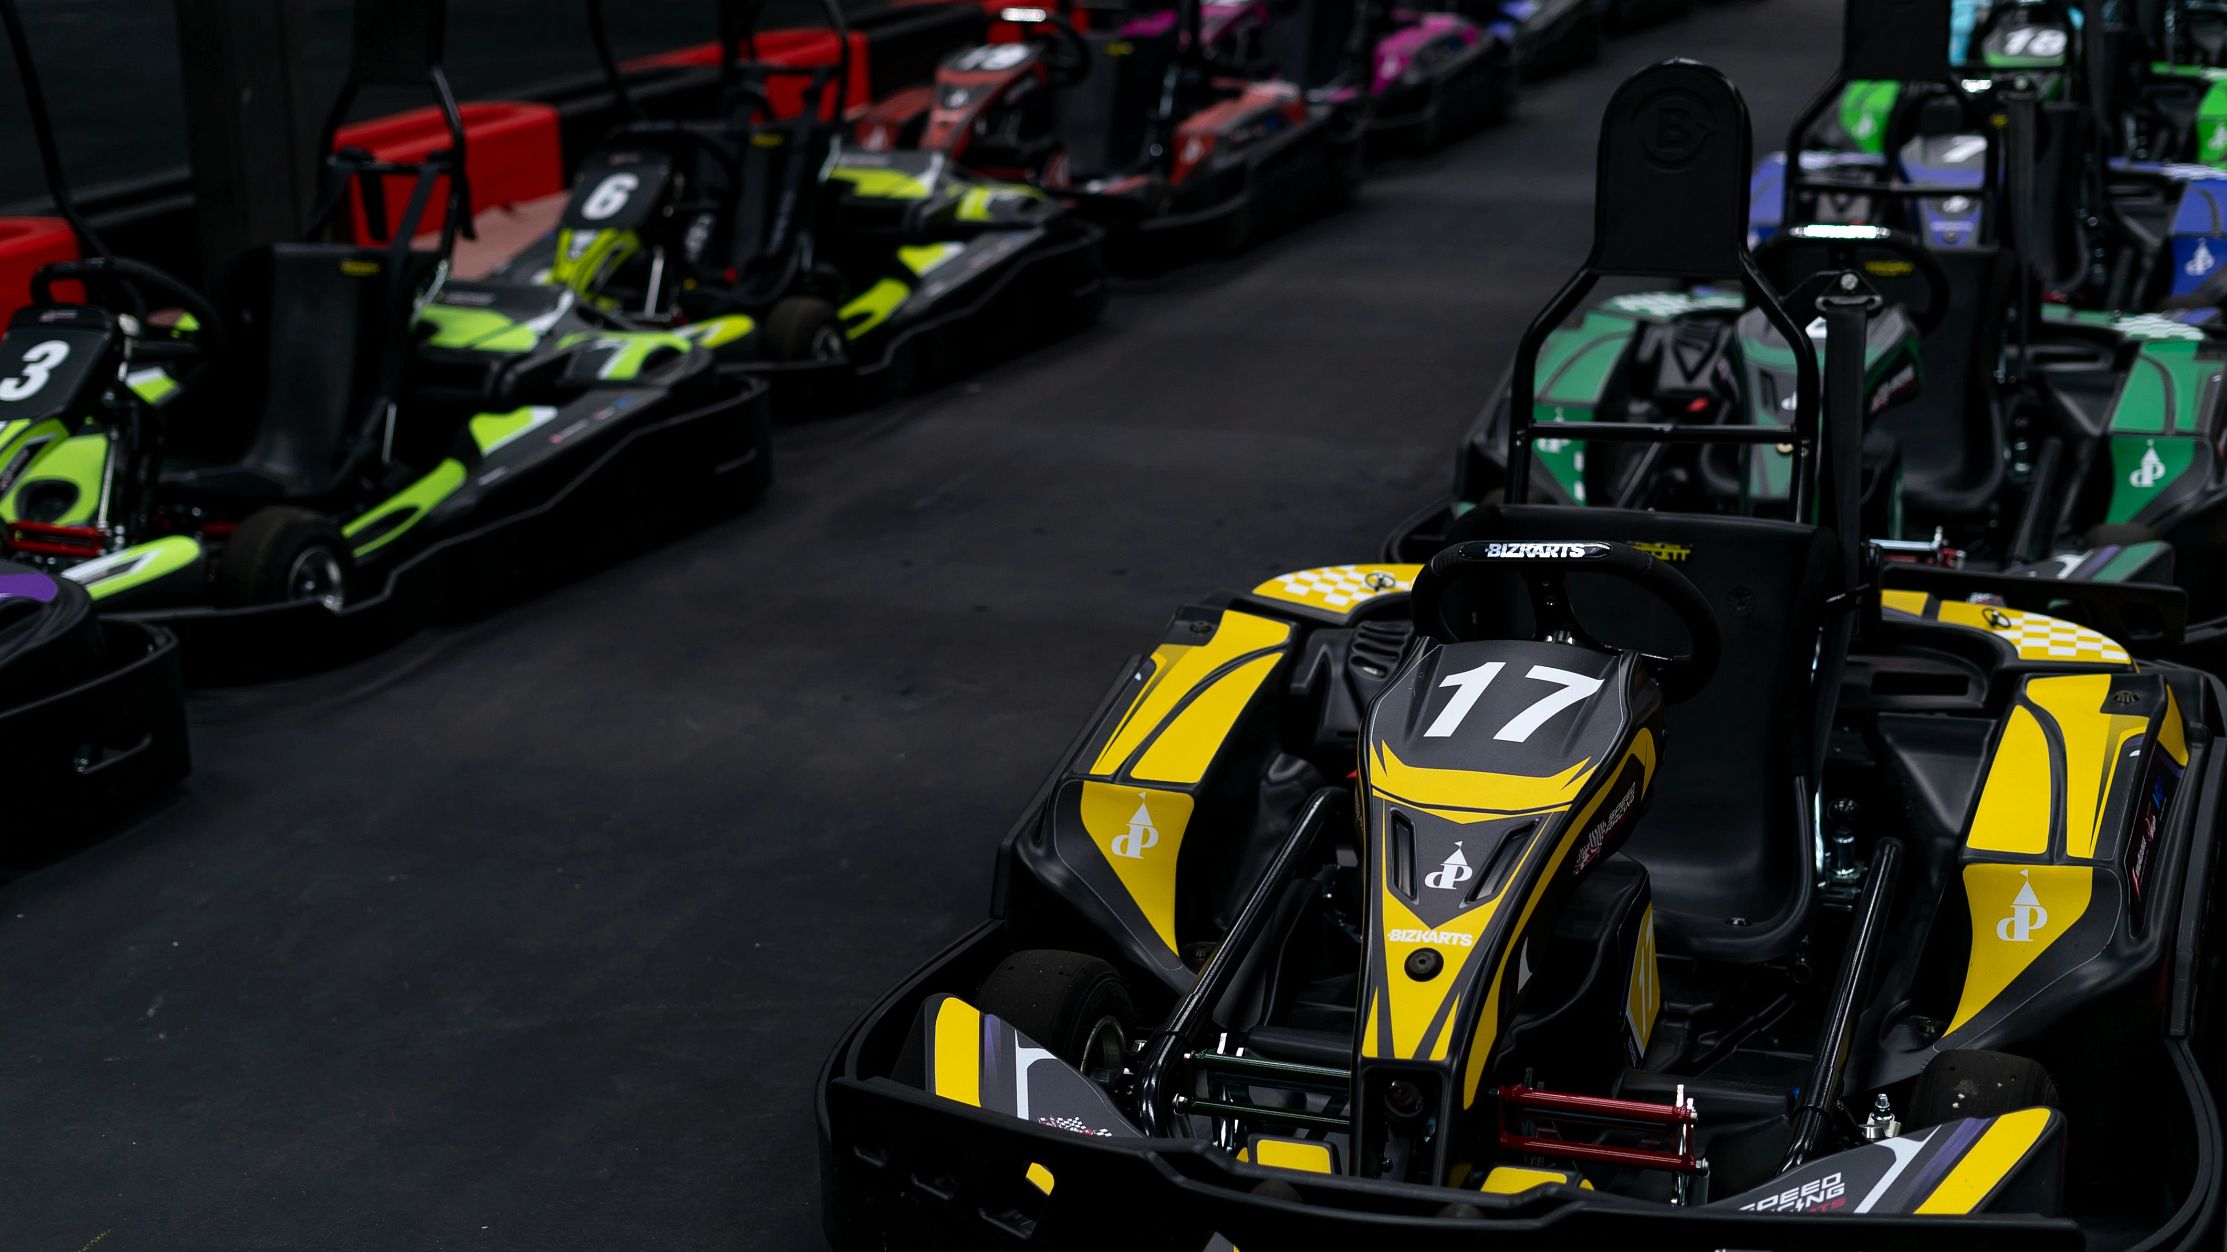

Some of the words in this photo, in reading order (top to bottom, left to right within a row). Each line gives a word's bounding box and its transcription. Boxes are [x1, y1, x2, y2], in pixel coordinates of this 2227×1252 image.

[581, 172, 639, 220] 6
[0, 340, 70, 401] 3
[1487, 543, 1586, 558] BIZKARTS
[1423, 661, 1606, 743] 17
[1388, 929, 1473, 947] BIZKARTS
